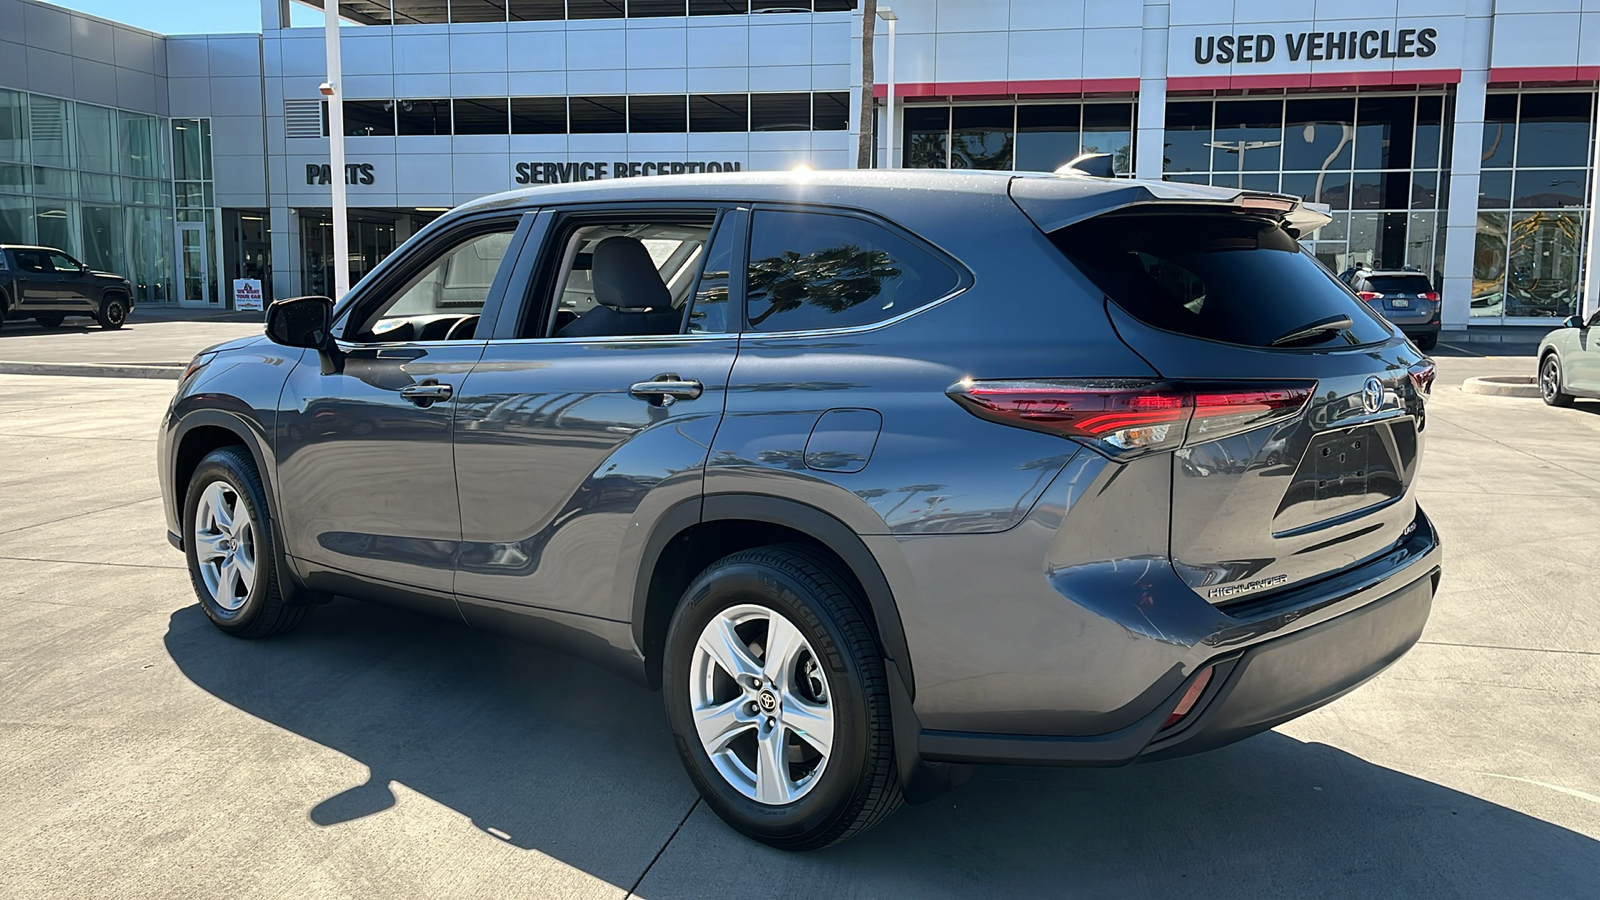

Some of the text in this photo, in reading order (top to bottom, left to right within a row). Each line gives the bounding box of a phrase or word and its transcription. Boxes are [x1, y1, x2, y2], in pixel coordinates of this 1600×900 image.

[1194, 28, 1438, 65] USED VEHICLES
[306, 163, 375, 185] PATS
[515, 161, 608, 184] SERVICE
[1207, 573, 1288, 599] HIGHLANDER
[781, 589, 845, 669] MICHELIN
